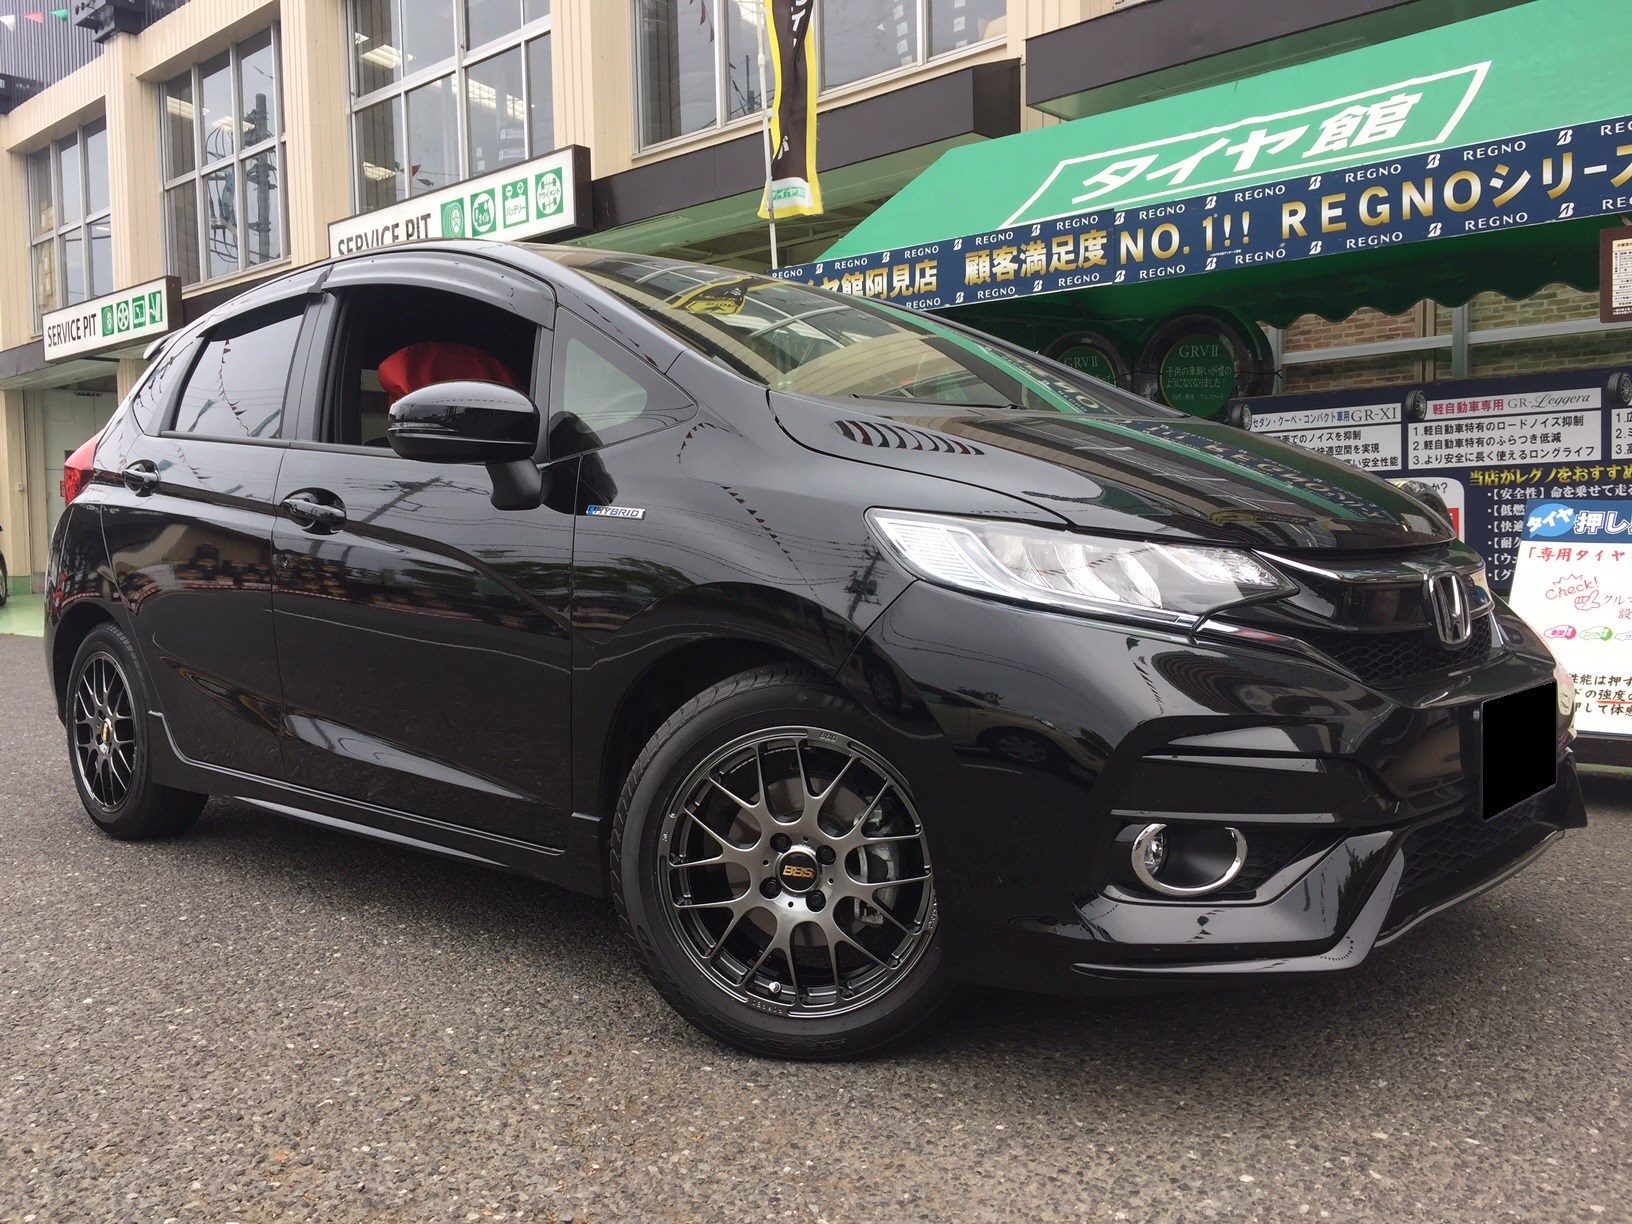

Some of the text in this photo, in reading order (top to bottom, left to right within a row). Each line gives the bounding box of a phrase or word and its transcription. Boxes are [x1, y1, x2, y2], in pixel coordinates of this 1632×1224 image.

[1071, 92, 1423, 204] タイヤ館
[538, 188, 560, 200] アライメント
[834, 257, 868, 271] REGNO
[904, 245, 939, 259] REGNO
[975, 231, 1014, 246] REGNO
[1056, 215, 1099, 231] REGNO
[1139, 204, 1186, 220] REGNO
[1234, 185, 1286, 203] REGNO
[1345, 163, 1401, 183] REGNO
[1463, 140, 1527, 161] REGNO
[338, 213, 431, 255] SERVICE PIT
[977, 285, 1016, 299] REGNO
[1058, 272, 1100, 287] REGNO
[1139, 264, 1186, 279] REGNO
[1234, 248, 1286, 265] REGNO
[1346, 231, 1403, 249] REGNO
[1465, 212, 1529, 231] REGNO
[808, 259, 938, 299] ヤ館阿見店
[47, 313, 97, 347] SERVICE PIT
[1351, 407, 1397, 422] GR-XI
[1432, 393, 1590, 416] 軽自動車専用 GR-Leggera
[594, 506, 640, 517] HYBRID
[1526, 508, 1632, 535] タイヤ 押し
[783, 865, 814, 878] BBS
